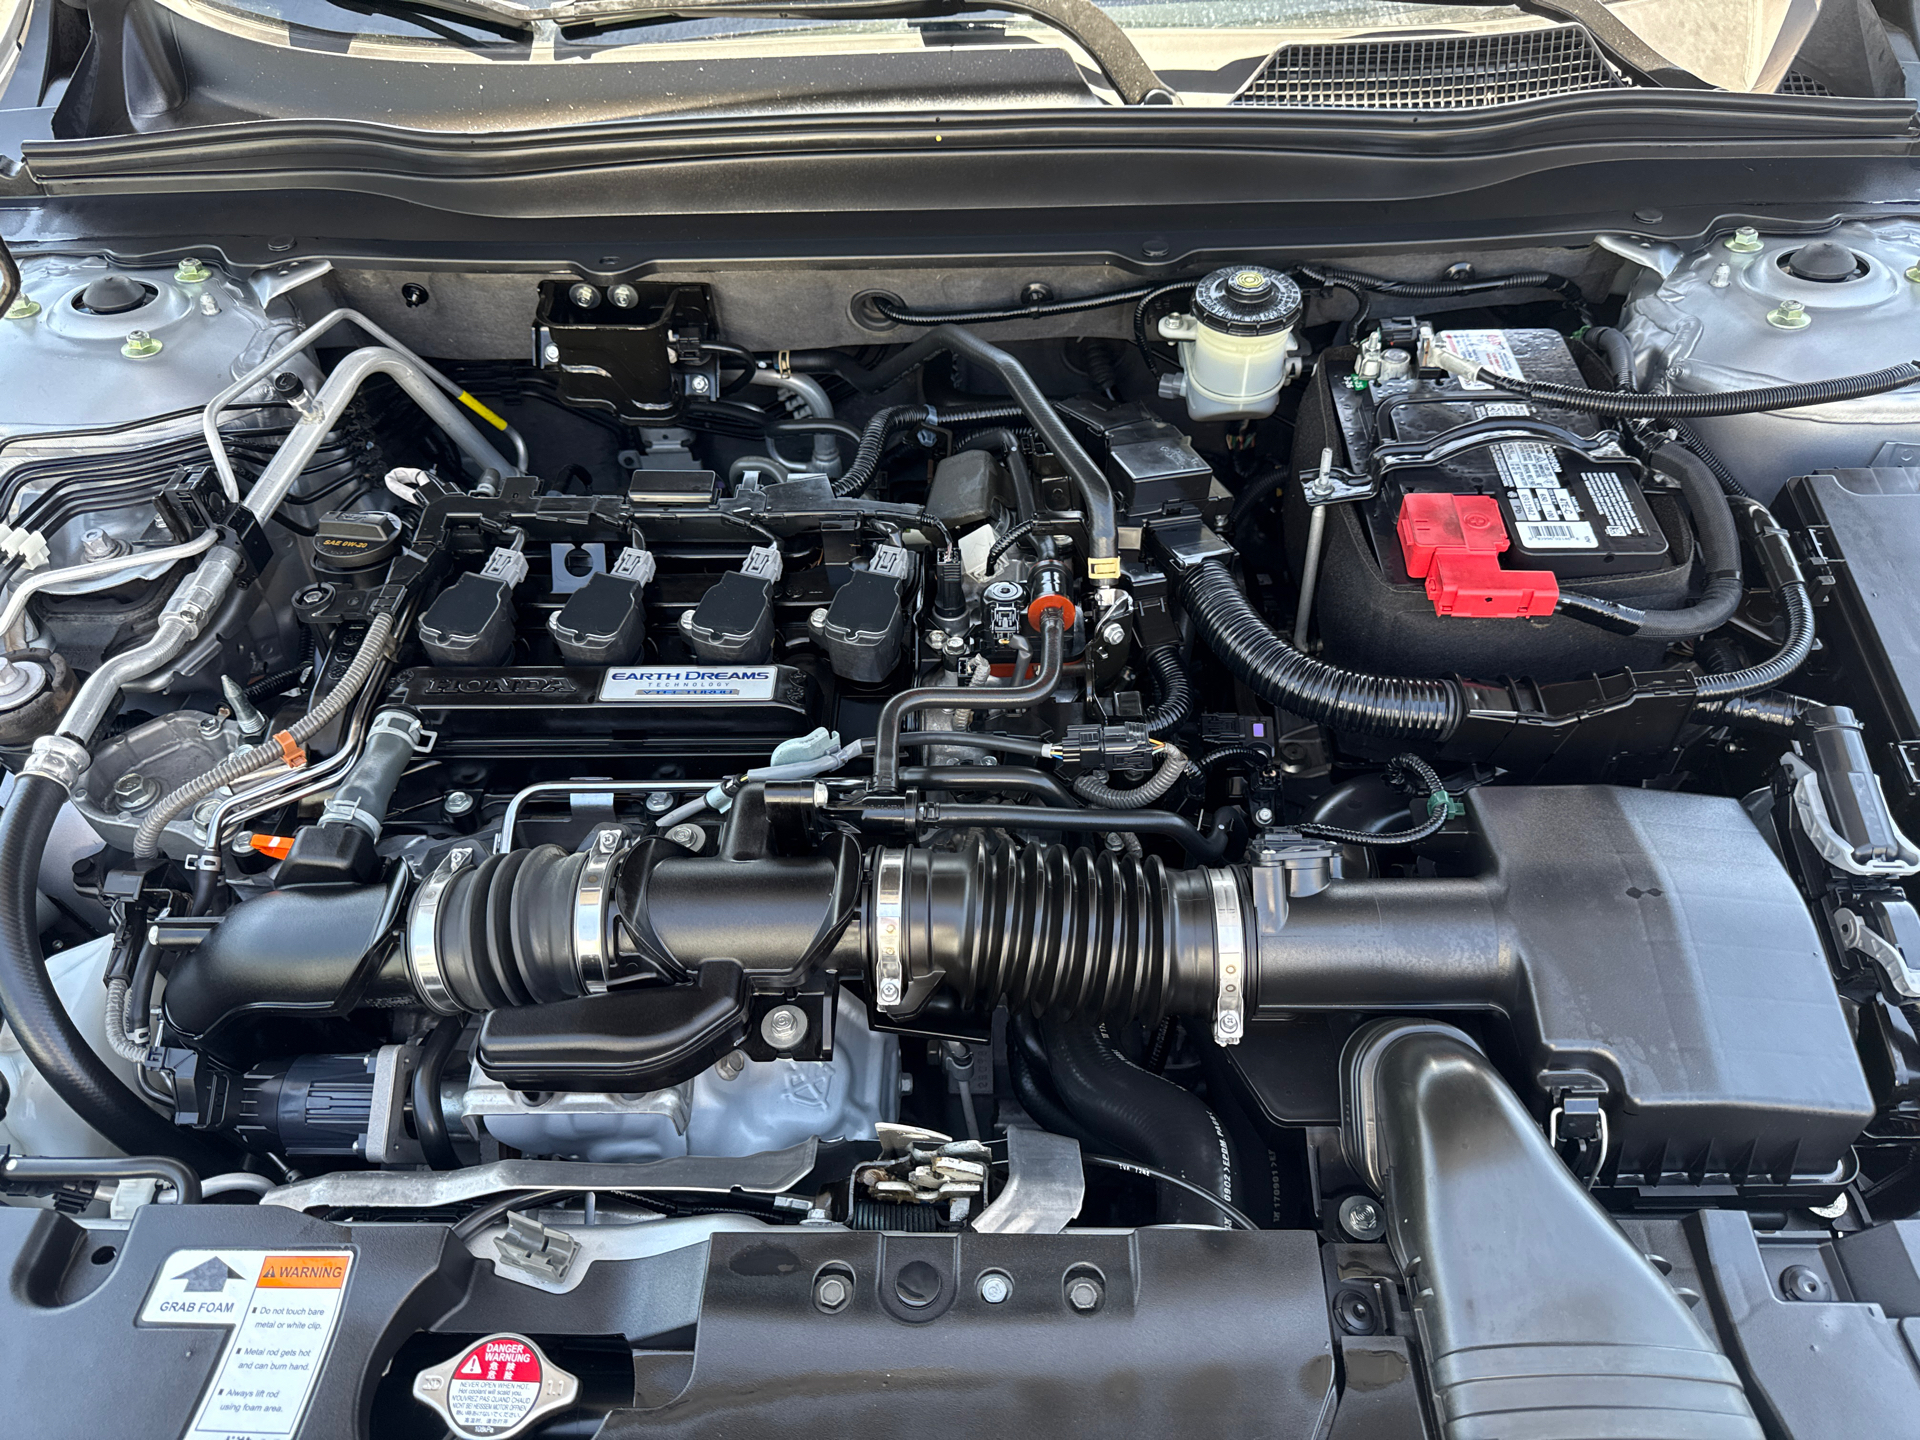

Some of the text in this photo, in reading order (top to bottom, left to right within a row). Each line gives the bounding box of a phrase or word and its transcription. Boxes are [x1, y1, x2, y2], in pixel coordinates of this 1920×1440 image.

[342, 540, 368, 549] 0W-20
[611, 671, 770, 681] EARTH DREAMS
[424, 677, 577, 694] HONDA
[1224, 1174, 1232, 1202] 0902
[279, 1266, 343, 1279] WARNING
[159, 1302, 235, 1313] GRAB FOAM
[260, 1306, 325, 1316] Do not touch bare
[255, 1320, 276, 1329] metal
[286, 1321, 307, 1330] white
[307, 1321, 322, 1331] clip.
[244, 1347, 311, 1358] Metal rod gets hot
[486, 1343, 524, 1354] DANGER
[485, 1352, 531, 1363] WARNUNG
[238, 1361, 254, 1369] and
[288, 1362, 310, 1371] hand.
[225, 1389, 280, 1399] Always lift rod
[219, 1403, 241, 1413] using
[242, 1403, 263, 1411] foam
